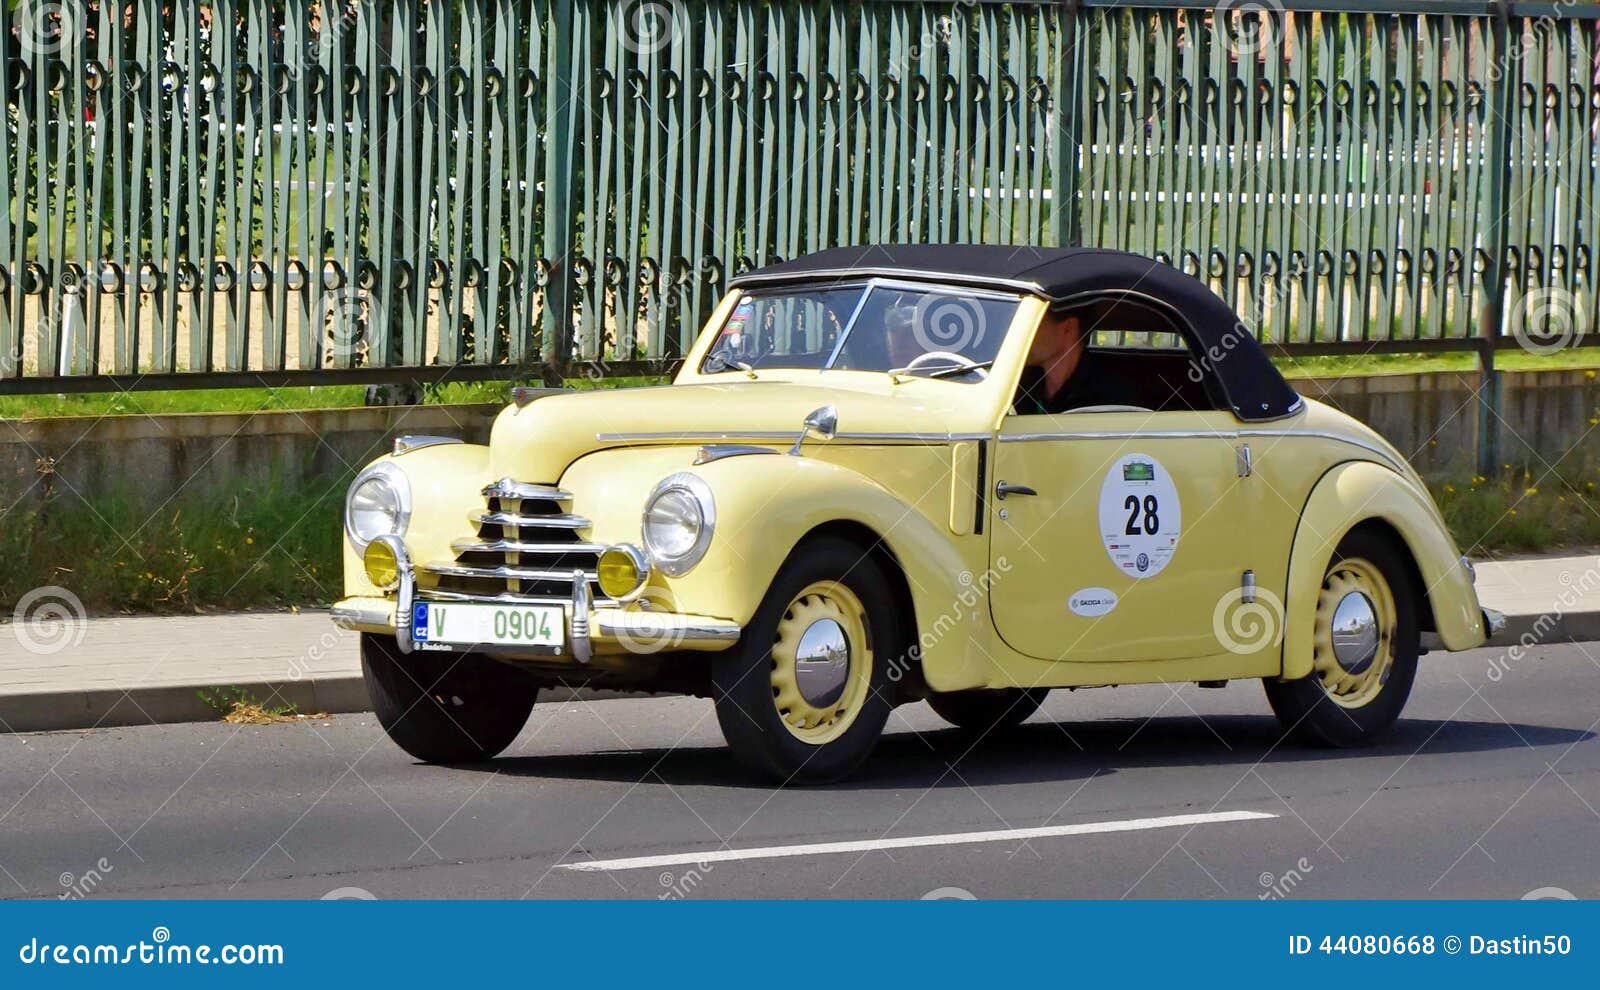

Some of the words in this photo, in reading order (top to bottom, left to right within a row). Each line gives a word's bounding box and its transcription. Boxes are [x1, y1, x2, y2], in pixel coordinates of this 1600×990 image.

[1124, 494, 1159, 535] 28
[415, 627, 428, 637] CZ
[434, 608, 446, 638] V
[494, 610, 552, 640] 0904
